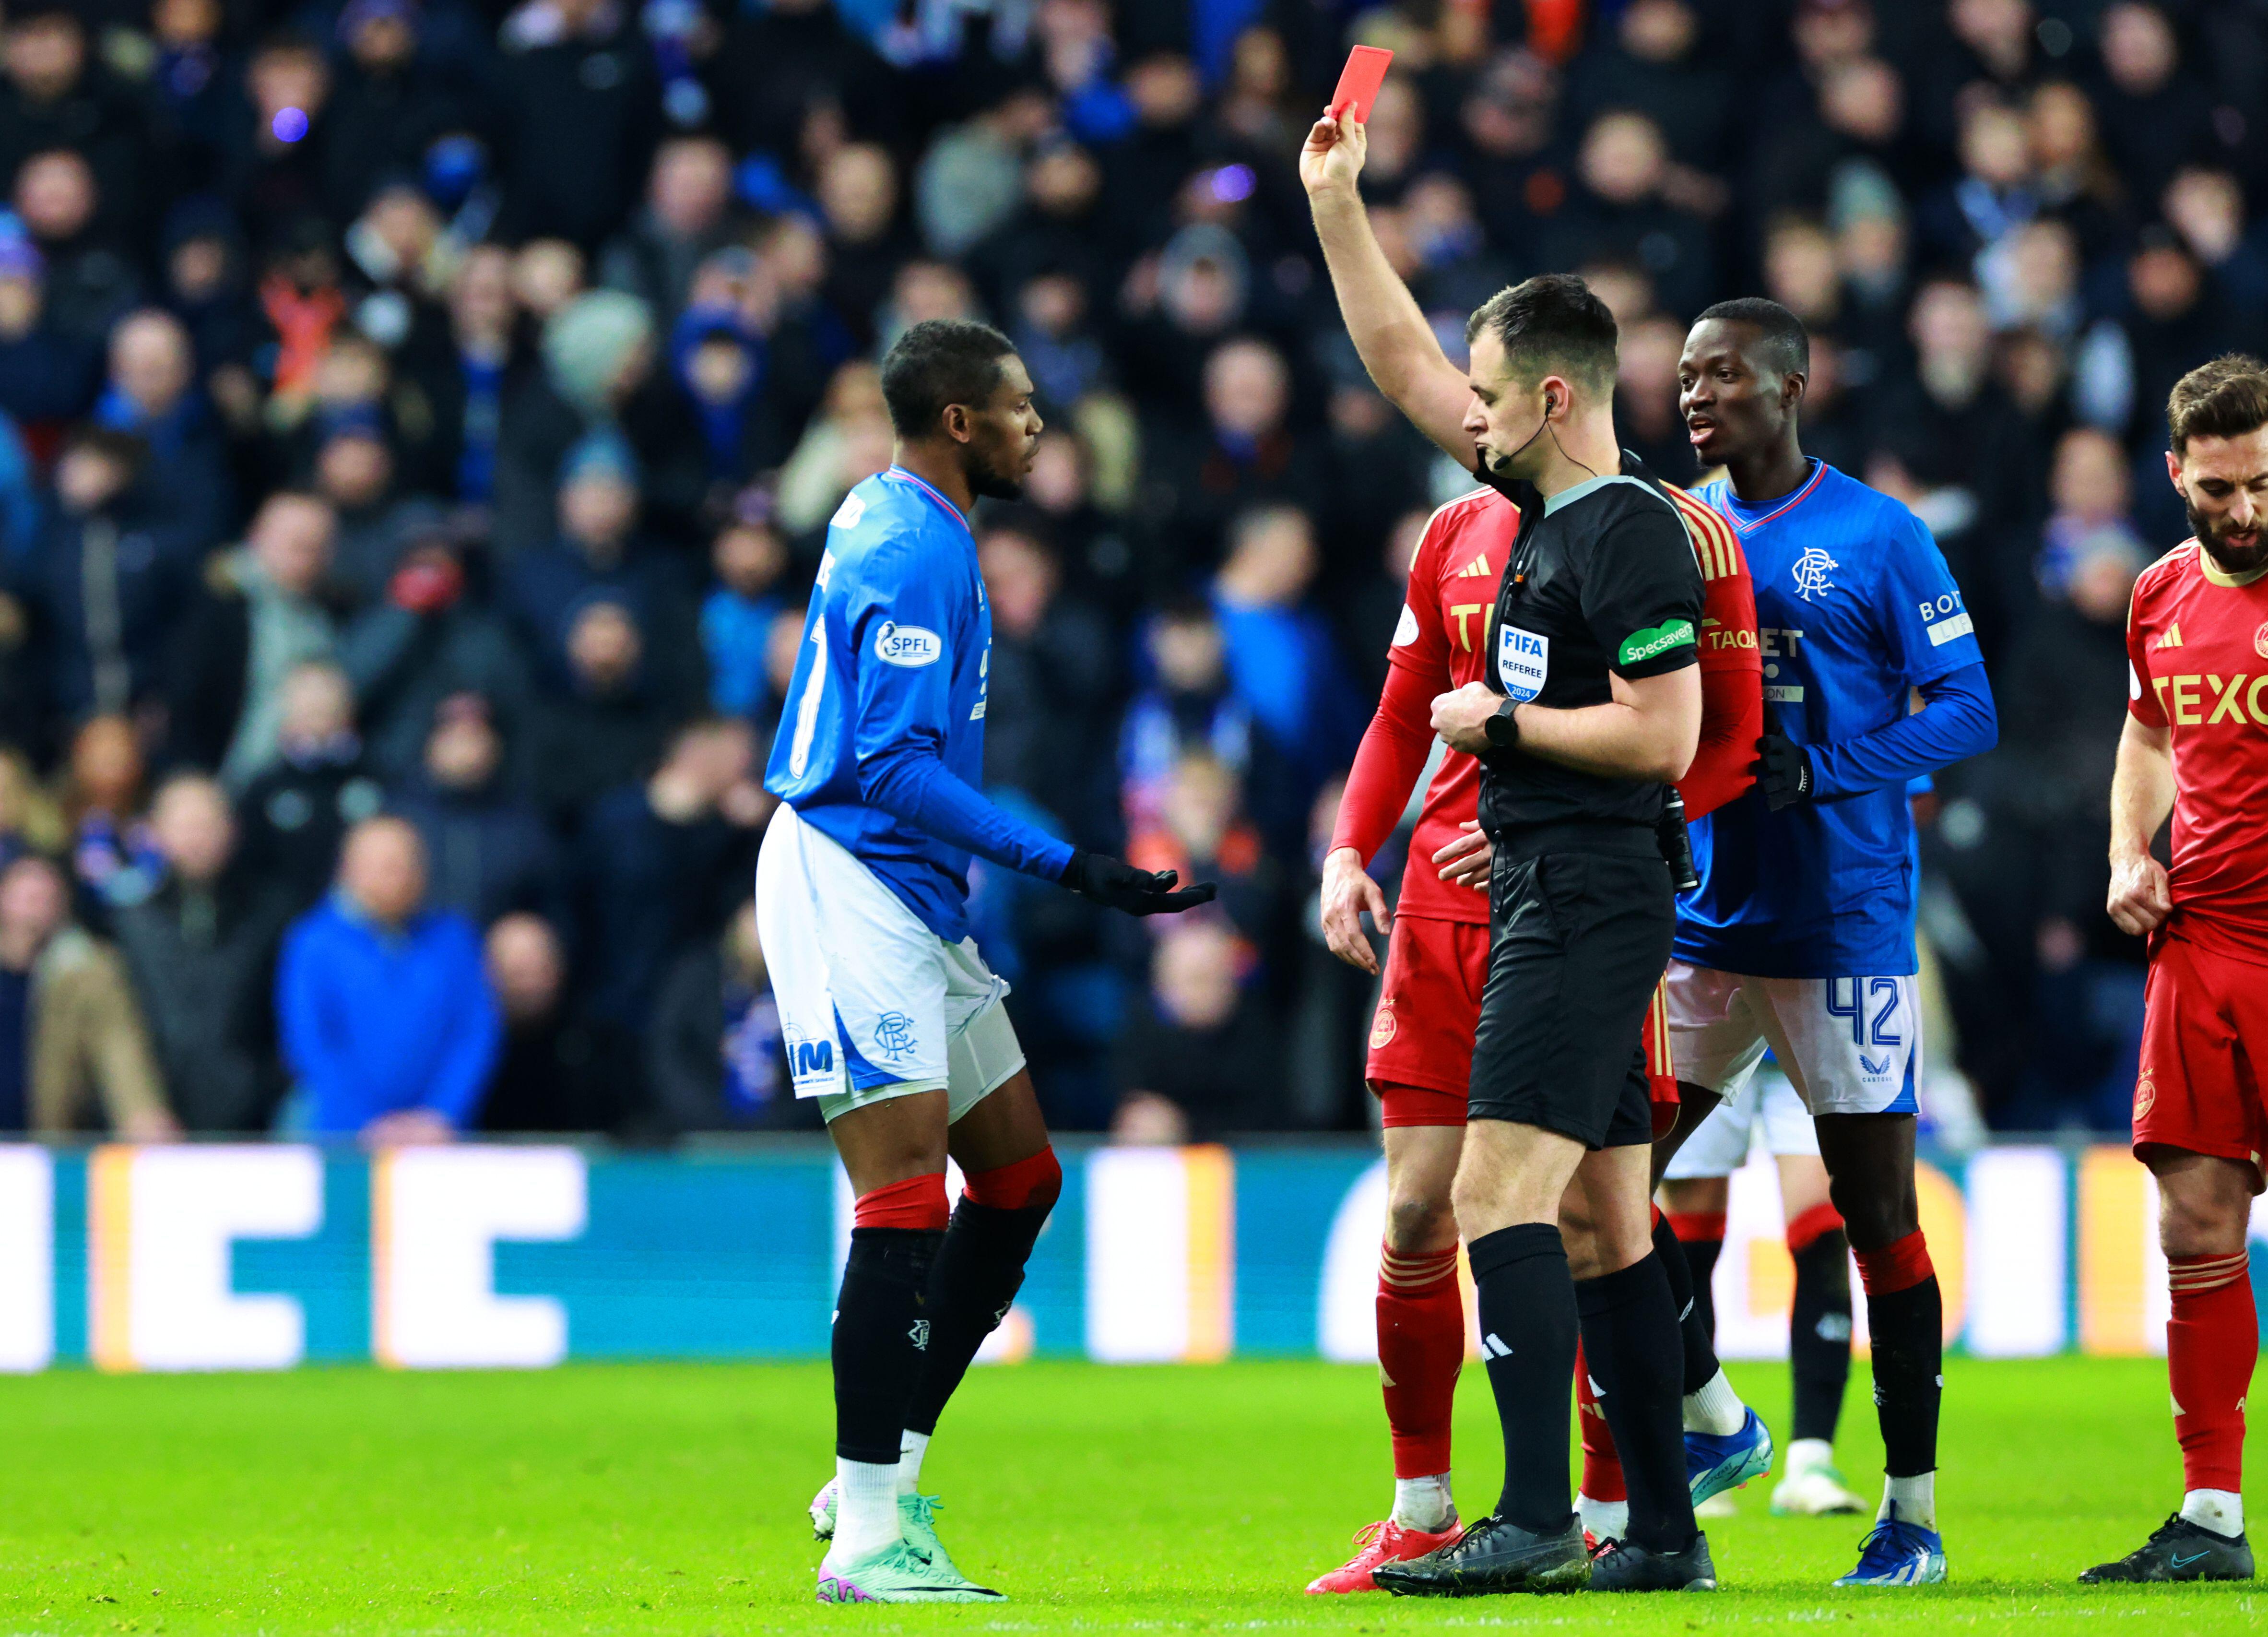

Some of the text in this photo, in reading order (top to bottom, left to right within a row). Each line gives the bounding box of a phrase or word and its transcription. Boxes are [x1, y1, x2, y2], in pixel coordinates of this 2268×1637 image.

[892, 632, 931, 651] SPFL
[1504, 631, 1543, 658] FIFA
[1627, 623, 1693, 661] Specsavers
[1708, 629, 1759, 650] TAQA
[1502, 659, 1542, 678] REFEREE
[1512, 686, 1531, 698] 2024
[1826, 977, 1902, 1048] 42
